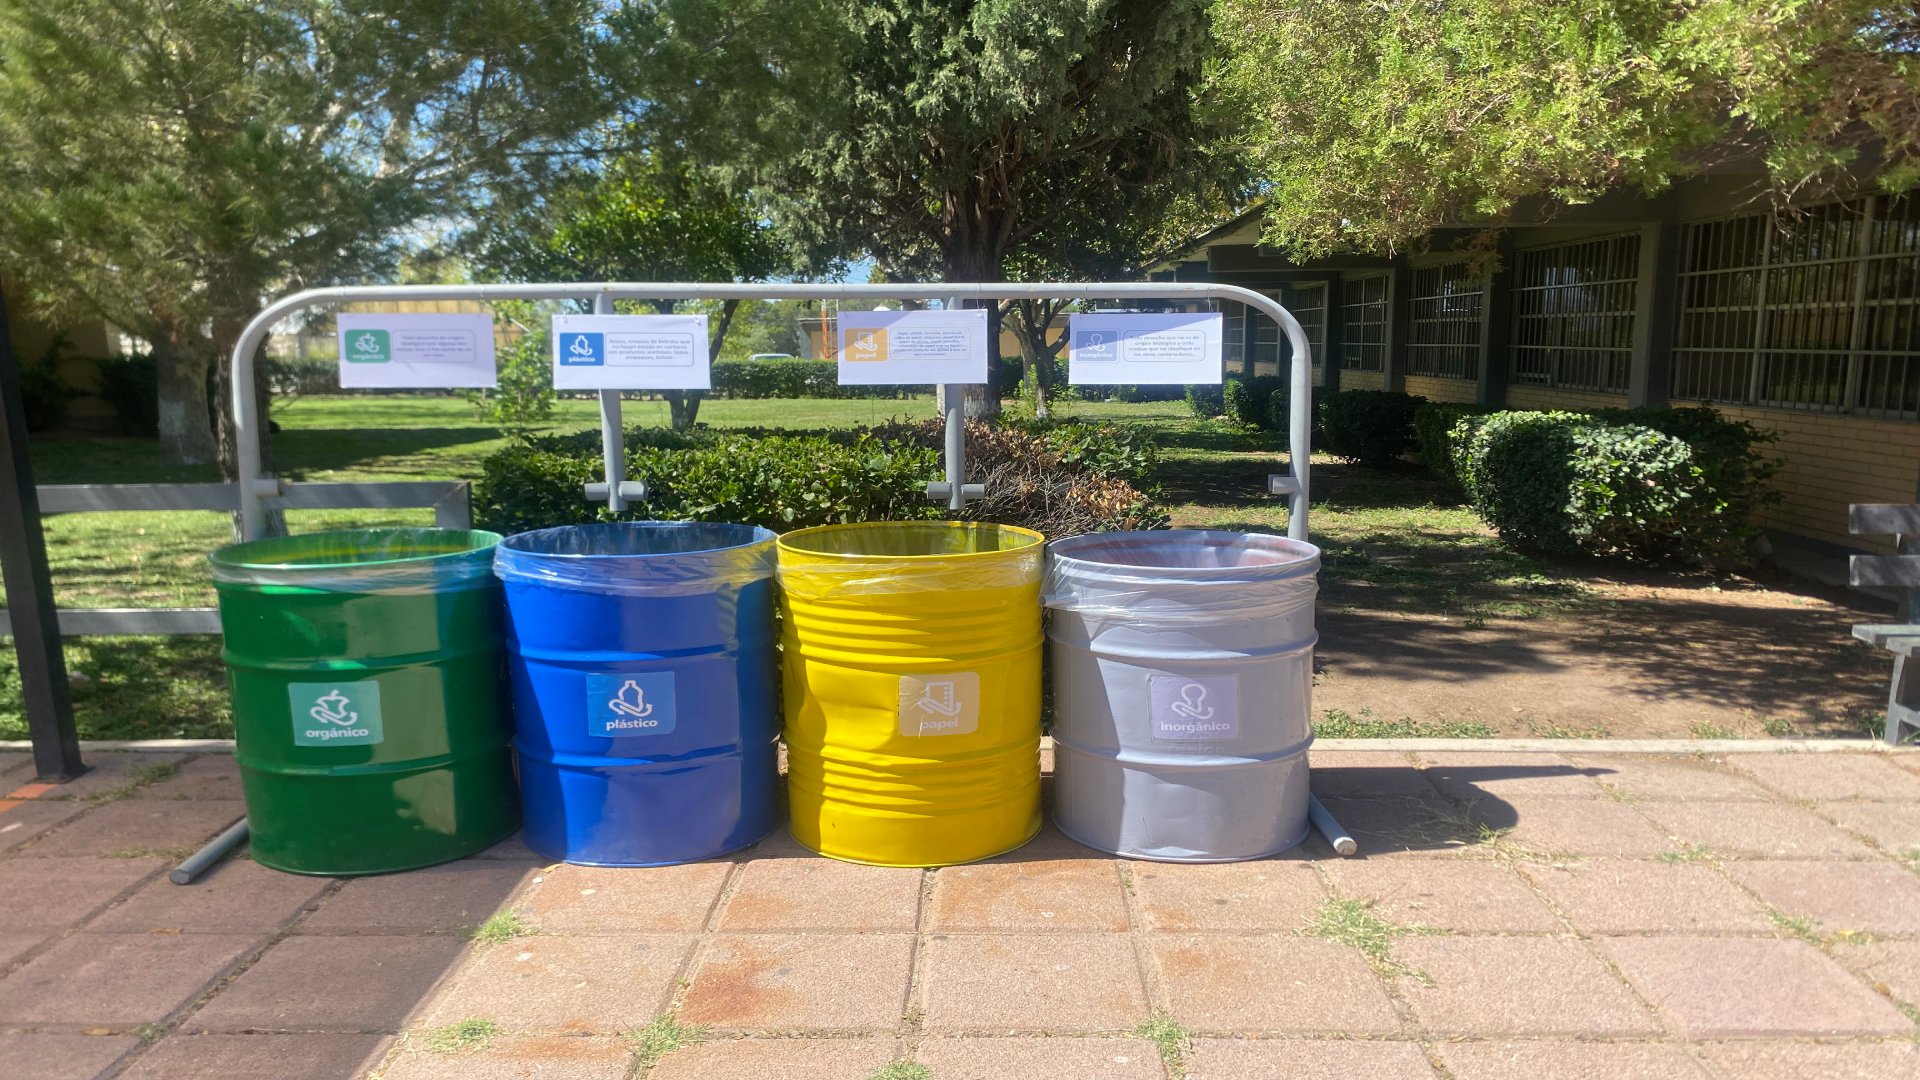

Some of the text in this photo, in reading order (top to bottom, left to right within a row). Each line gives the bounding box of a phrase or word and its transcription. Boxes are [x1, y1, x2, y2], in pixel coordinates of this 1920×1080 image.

[606, 718, 657, 731] plástico
[920, 718, 959, 730] papel
[1160, 721, 1230, 733] inorgánico
[306, 727, 369, 740] orgánico
